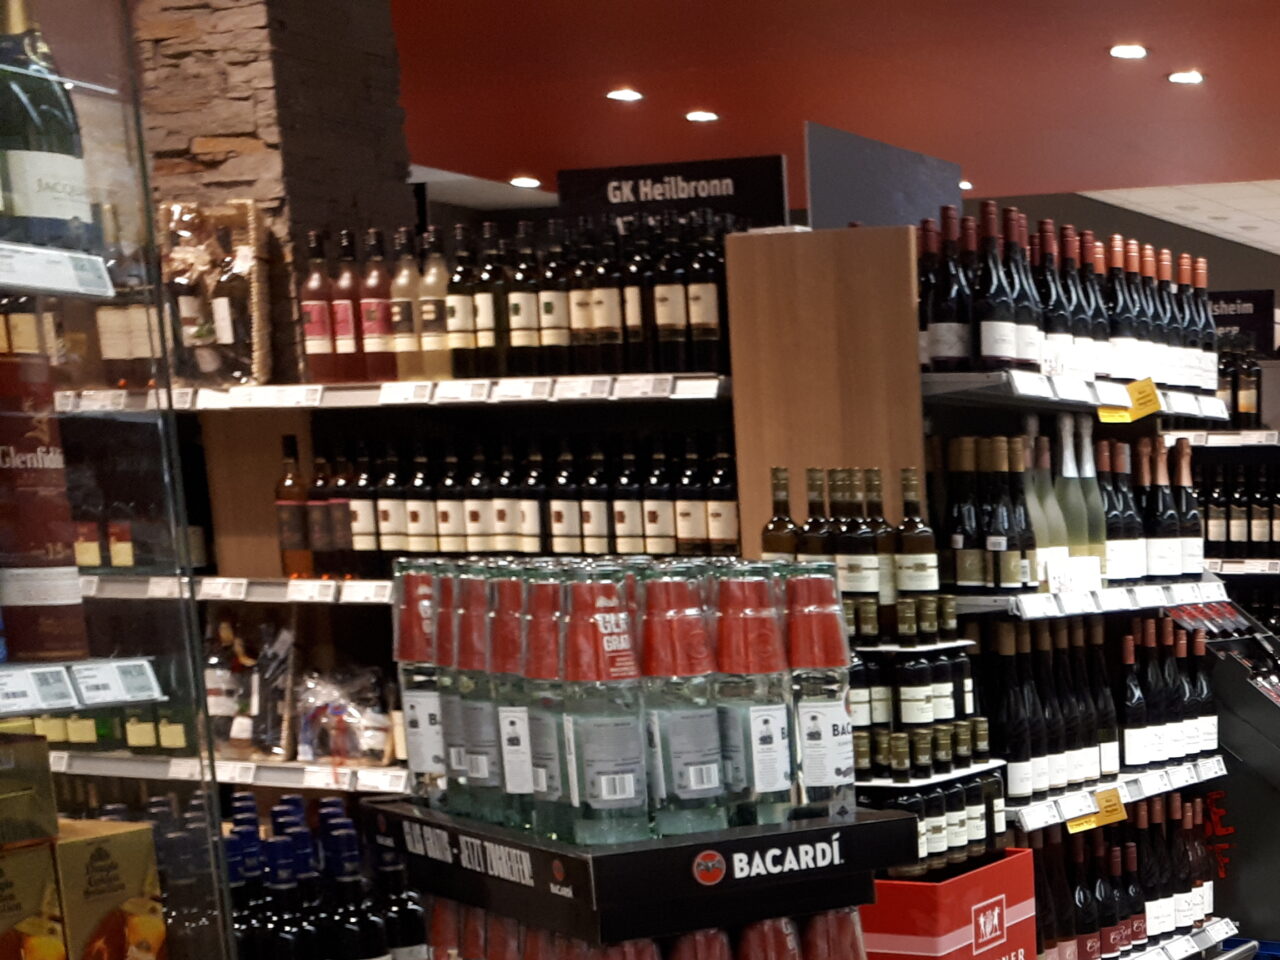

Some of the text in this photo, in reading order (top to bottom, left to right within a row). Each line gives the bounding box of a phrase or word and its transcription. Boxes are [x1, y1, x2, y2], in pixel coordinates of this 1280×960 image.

[608, 175, 734, 204] GK Heilbronn
[732, 832, 841, 879] BACARDÍ
